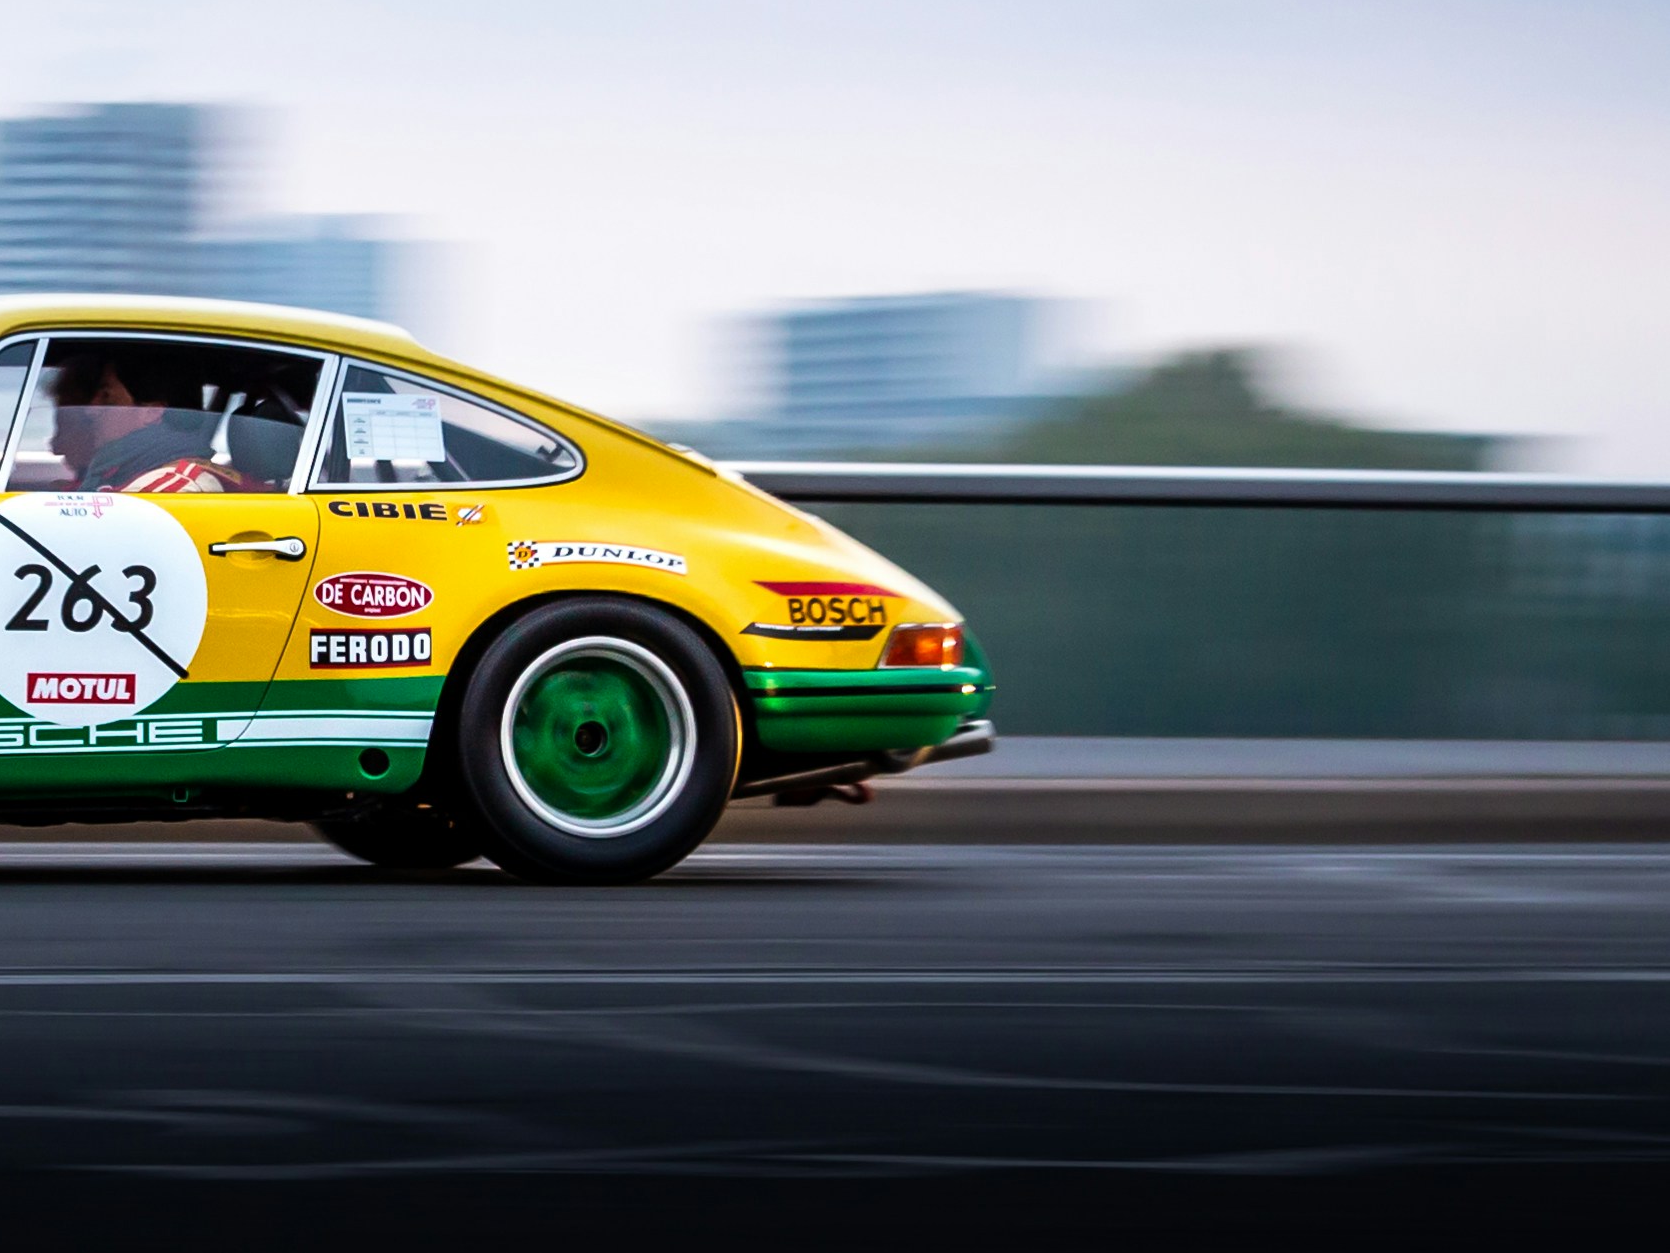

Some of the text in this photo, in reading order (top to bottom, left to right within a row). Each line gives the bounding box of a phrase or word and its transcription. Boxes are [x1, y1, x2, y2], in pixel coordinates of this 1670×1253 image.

[59, 507, 88, 517] AUTO
[552, 546, 683, 567] DUNLOP
[4, 563, 157, 633] 263
[322, 583, 426, 607] DE CARBON
[787, 597, 887, 624] BOSCH
[311, 633, 431, 663] FERODO
[31, 677, 131, 701] MOTUL
